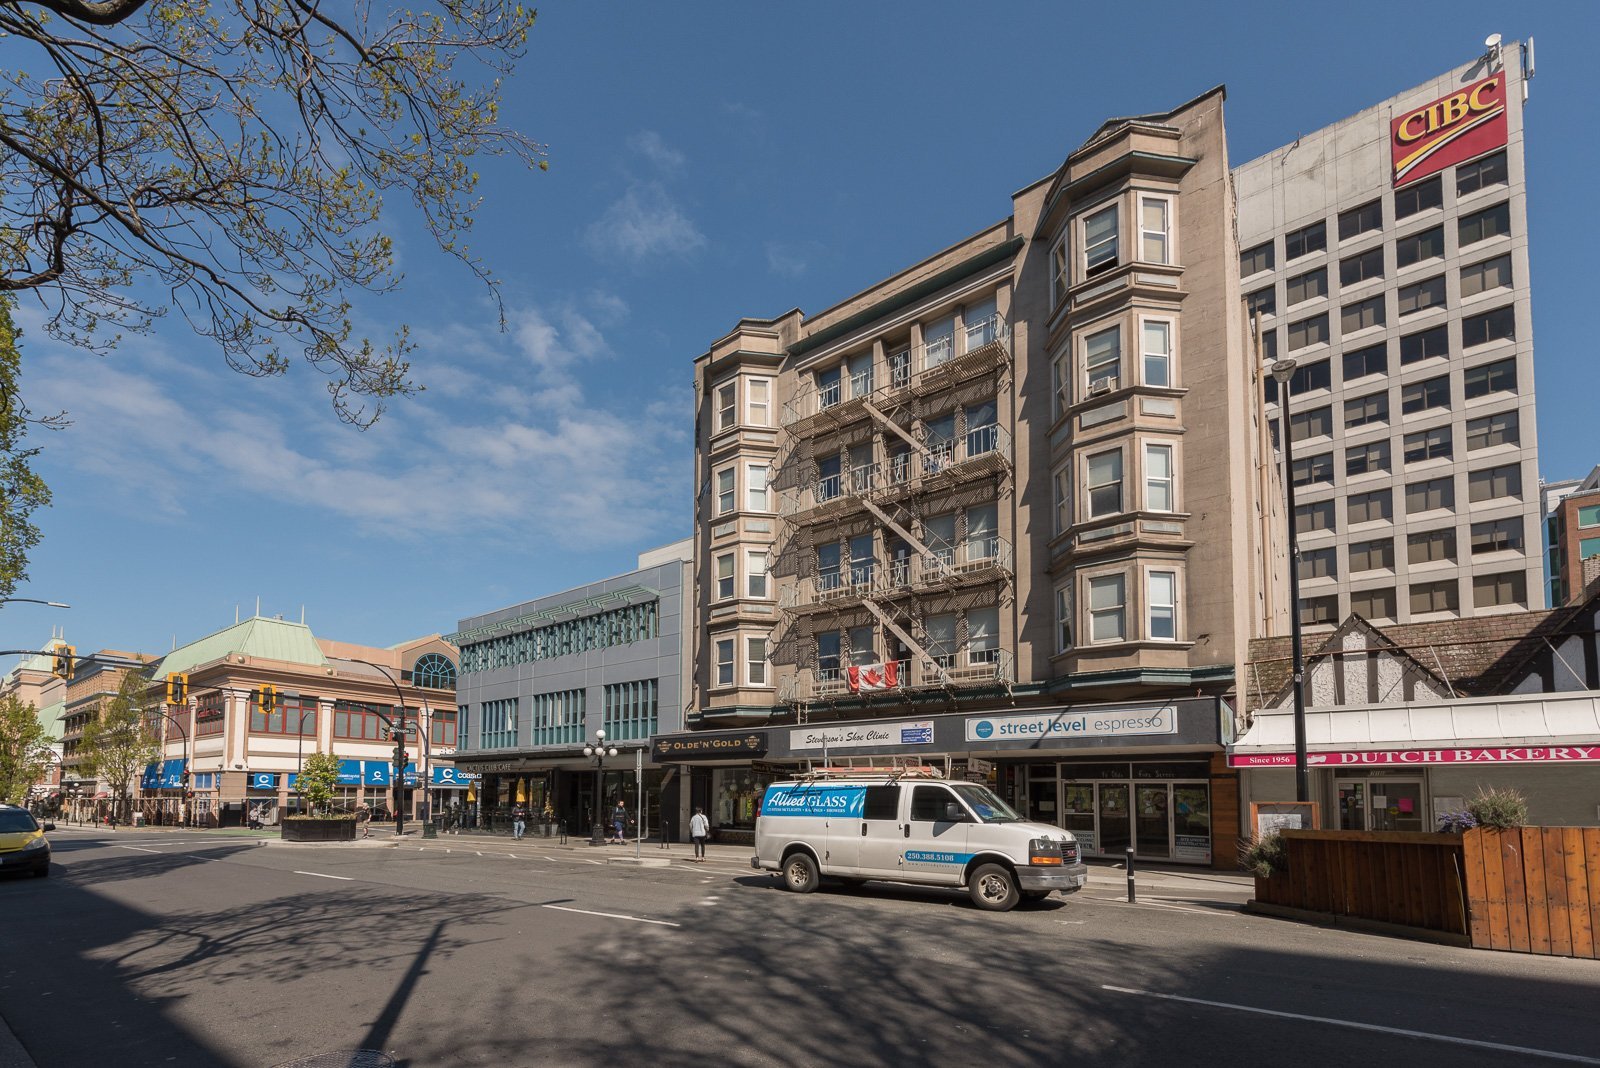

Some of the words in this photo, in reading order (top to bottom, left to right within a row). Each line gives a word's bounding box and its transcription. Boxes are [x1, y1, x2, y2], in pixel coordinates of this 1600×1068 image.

[1398, 77, 1500, 141] CIBC
[1000, 720, 1044, 735] street
[1048, 717, 1086, 732] level
[1094, 715, 1163, 731] espresso
[805, 734, 844, 744] Stevson's
[845, 731, 864, 742] Shoe
[866, 729, 890, 741] Clinic
[1249, 756, 1270, 764] Since
[1271, 755, 1290, 763] 1956
[1340, 750, 1444, 764] DUTCH
[1453, 747, 1595, 761] BAKERY
[768, 791, 806, 807] Allied
[807, 795, 848, 807] GLASS
